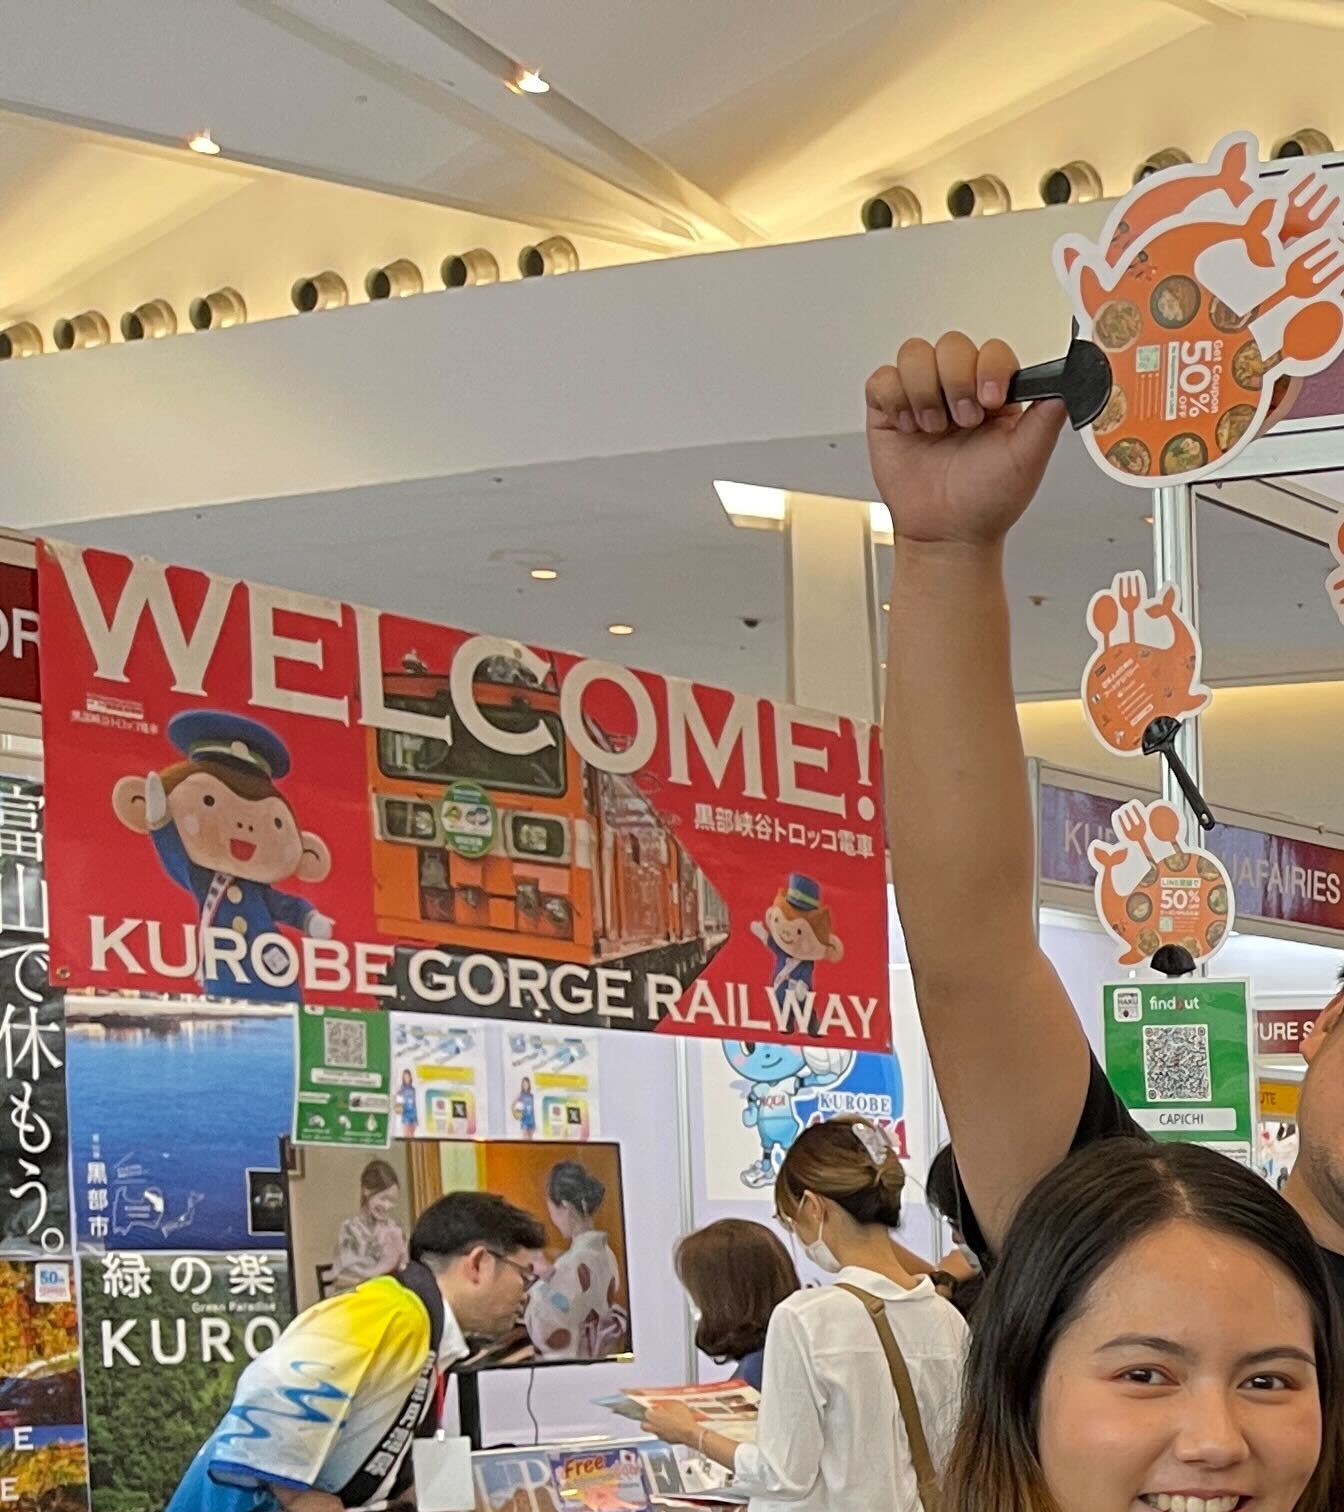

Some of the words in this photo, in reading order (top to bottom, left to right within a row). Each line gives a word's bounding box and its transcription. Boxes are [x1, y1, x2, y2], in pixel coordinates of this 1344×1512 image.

[1180, 340, 1212, 417] 50%
[53, 544, 880, 823] WELCOME!
[693, 802, 876, 860] 黒部峡谷トロッコ電車
[1160, 890, 1200, 910] 50%
[89, 915, 397, 996] KUROBE
[408, 950, 633, 1020] GORGE
[647, 972, 879, 1040] RAILWAY
[820, 1097, 890, 1112] KUROBE
[1159, 1113, 1203, 1125] CAPICHI
[87, 1162, 109, 1237] 黒部市
[102, 1252, 275, 1299] 緑の楽
[100, 1316, 281, 1368] KURO
[563, 1455, 604, 1478] Free
